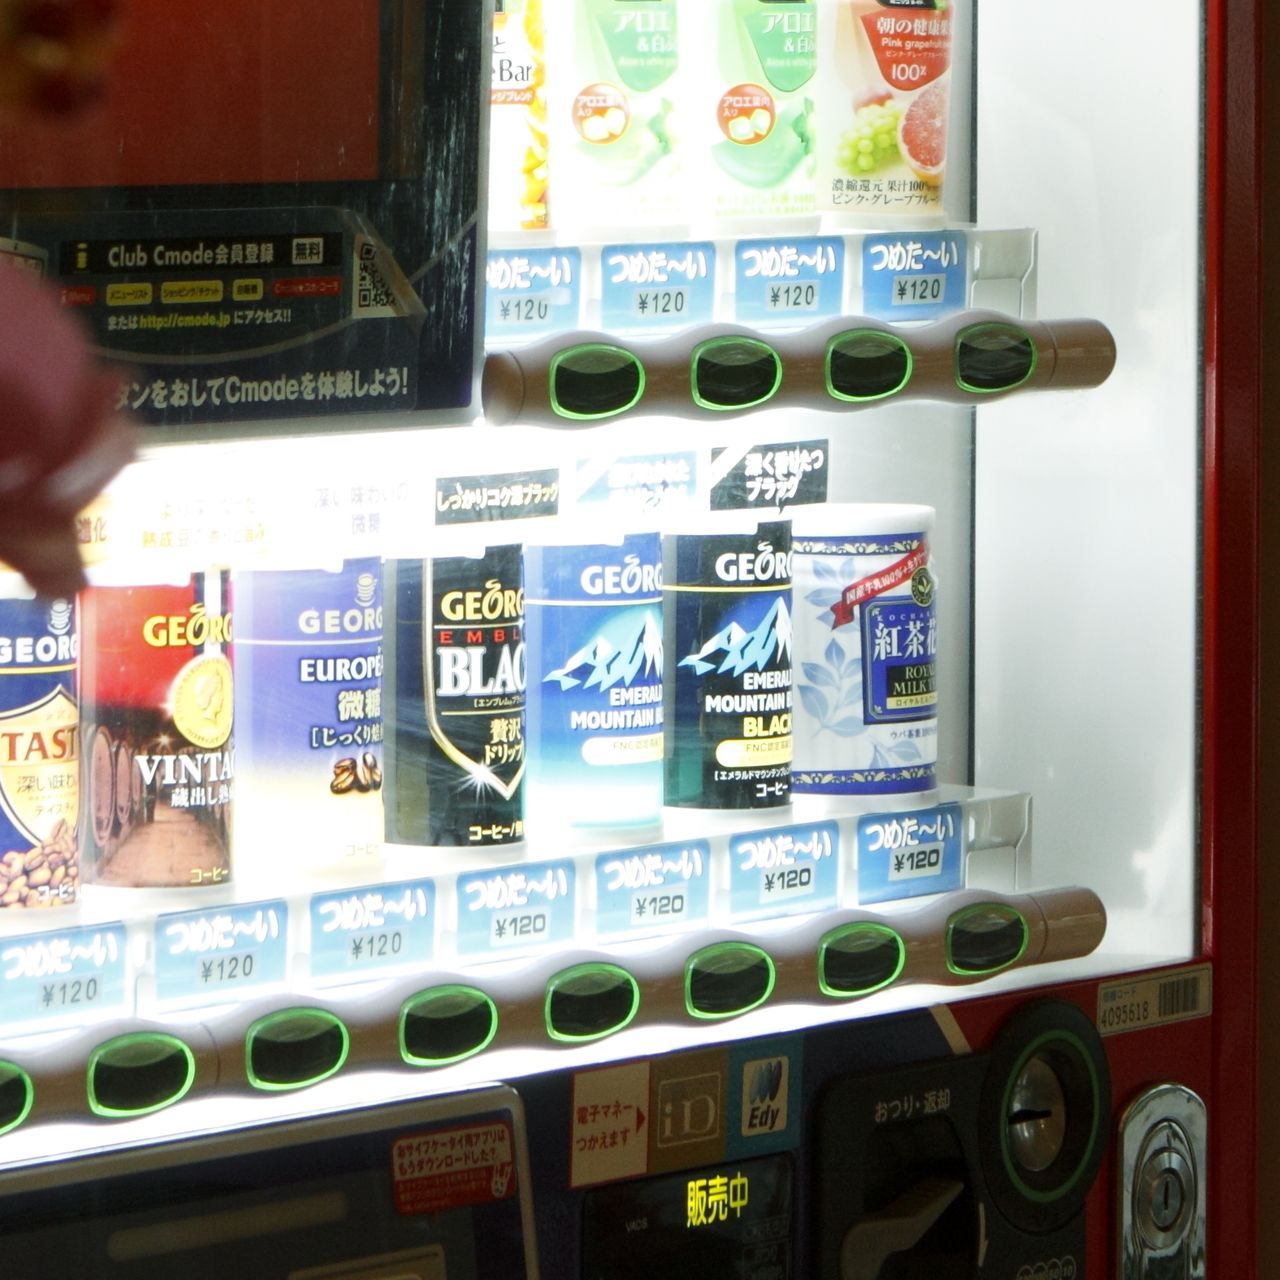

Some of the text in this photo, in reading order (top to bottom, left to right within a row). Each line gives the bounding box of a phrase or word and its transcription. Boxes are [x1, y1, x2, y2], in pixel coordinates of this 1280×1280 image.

[108, 244, 148, 267] Club
[770, 285, 815, 309] ¥120
[896, 277, 942, 301] ¥120
[638, 290, 686, 315] ¥120
[893, 679, 926, 696] MILK
[705, 694, 785, 714] MOUNTAIN
[570, 707, 656, 731] MOUNTAIN
[892, 848, 941, 873] ¥120
[763, 866, 812, 891] ¥120
[635, 894, 685, 918] ¥120
[494, 914, 546, 938] ¥120
[351, 932, 403, 957] ¥120
[200, 955, 254, 983] ¥120
[41, 978, 99, 1007] ¥120
[576, 1101, 634, 1125] 電子マネー
[660, 1094, 716, 1138] iD
[874, 1088, 951, 1123] おつり・返却
[747, 1104, 781, 1132] Edy
[576, 1128, 631, 1151] つかえます
[686, 1170, 749, 1228] 販売中
